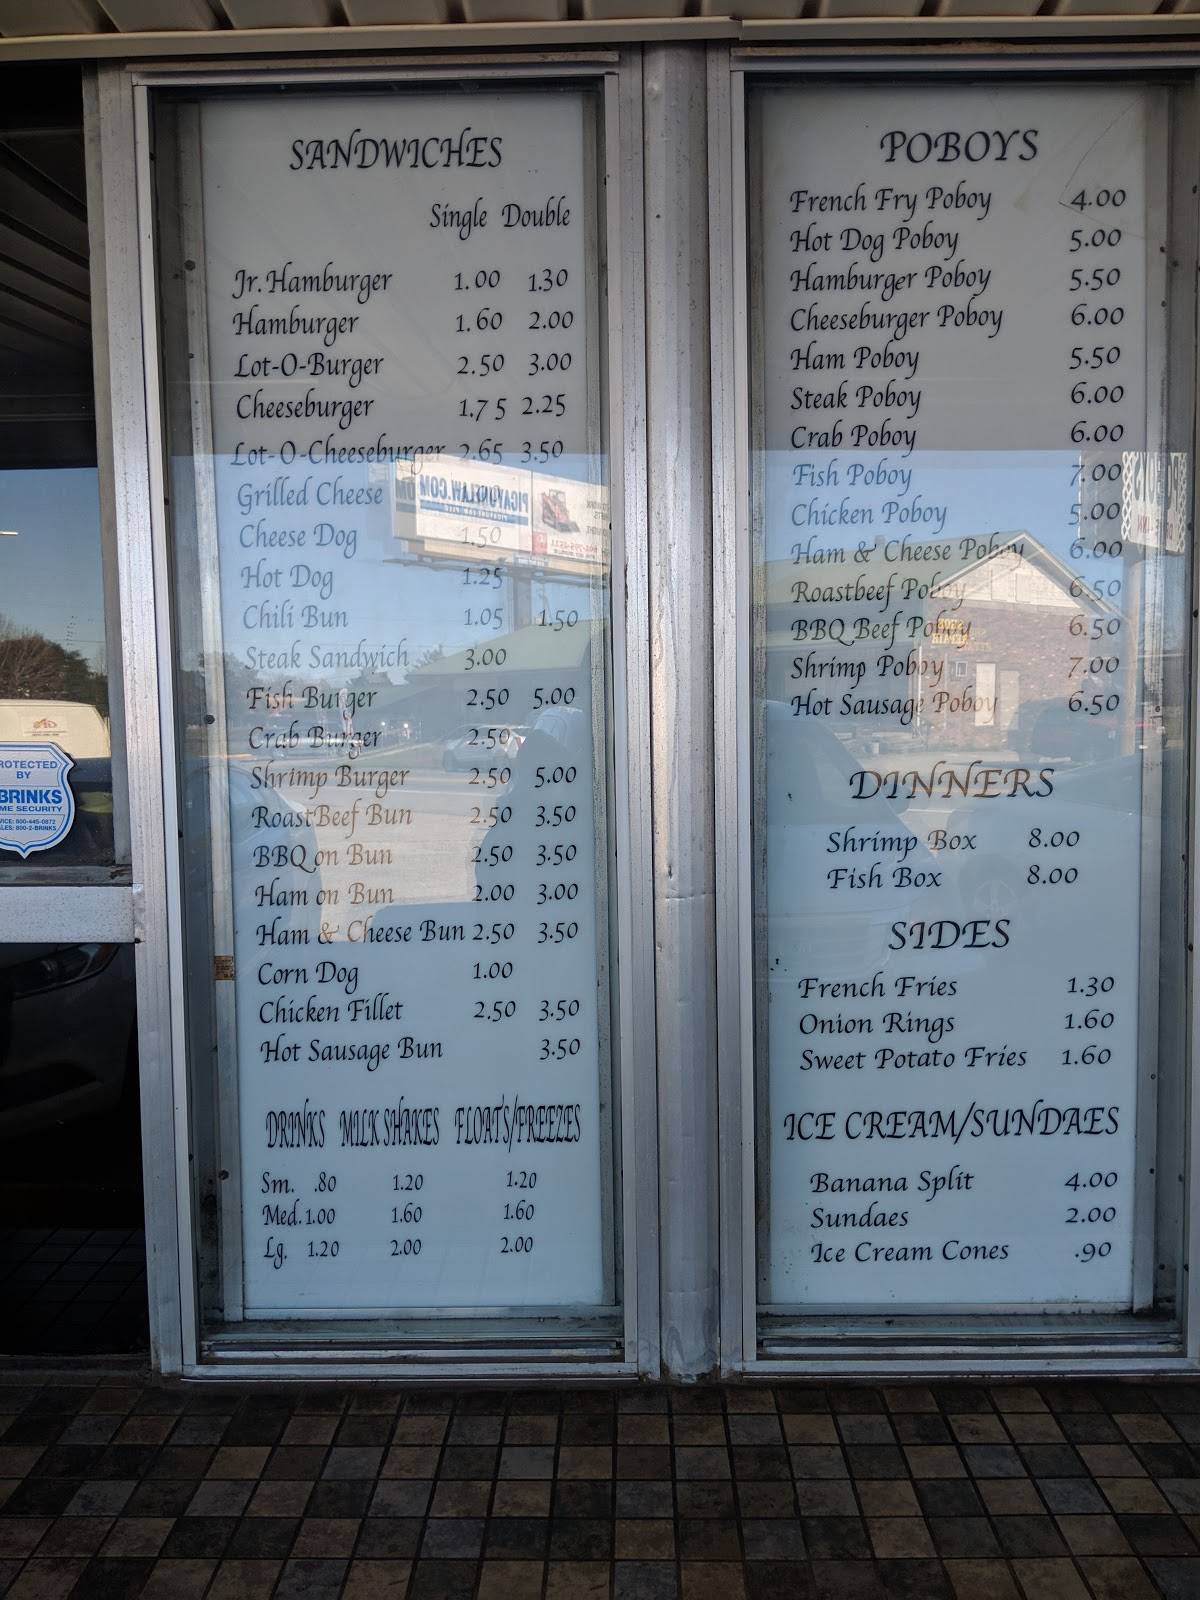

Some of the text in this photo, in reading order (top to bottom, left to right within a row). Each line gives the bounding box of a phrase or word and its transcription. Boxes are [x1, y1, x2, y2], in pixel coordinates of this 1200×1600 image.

[290, 127, 502, 170] SANDWICHES
[880, 129, 1038, 163] POBOYS
[430, 196, 570, 240] Single Double
[790, 180, 1126, 222] French Fry Poboy 4.00
[790, 220, 1121, 263] Hot Dog Poboy 5.00
[266, 261, 568, 304] Hamburger 1.00 1.30
[790, 259, 1120, 301] Hamburger Poboy 5.50
[233, 304, 573, 347] Hamburger 1.60 2.00
[790, 297, 1124, 340] Cheeseburger Poboy 6.00
[234, 353, 571, 388] Lot-O-Burger 2.50 3.00
[791, 339, 1120, 379] Ham Poboy 5.50
[237, 388, 565, 430] Cheeseburger 2.25
[791, 379, 1124, 419] Steak Poboy 6.00
[791, 418, 1123, 458] Crab Poboy 6.00
[237, 477, 308, 515] Grilled
[316, 475, 382, 505] Cheese
[793, 458, 912, 497] Fish Poboy
[792, 494, 947, 534] Chicken Poboy
[240, 518, 357, 559] Cheese Dog
[791, 535, 846, 564] Ham
[241, 558, 333, 600] Hot Dog
[792, 573, 898, 613] Roastbeef
[243, 599, 348, 629] Chili Bun
[791, 610, 904, 649] BBQ Beef
[244, 638, 506, 671] Steak Sandwich 3.00
[791, 649, 944, 691] Shrimp Poboy
[247, 680, 575, 721] Fish Burger 2.50 5.00
[791, 687, 1120, 725] Hot Sausage Poboy 6.50
[248, 721, 383, 760] Crab Burger
[0, 760, 58, 769] ROTECTED
[16, 771, 31, 779] BY
[250, 759, 576, 800] Shrimp Burger 2.50 5.00
[849, 760, 1056, 799] DINNERS
[0, 789, 63, 804] BRINKS
[251, 798, 576, 839] RoastBeef Bun 3.50
[253, 845, 576, 873] BBQ 2.50 3.50
[827, 826, 1079, 863] Shrimp Box 8.00
[255, 877, 578, 907] Ham 2.00 3.00
[827, 862, 1078, 888] Fish Box 8.00
[256, 916, 578, 946] Ham Cheese Bun 2.50 3.50
[888, 919, 1010, 950] SIDES
[258, 963, 308, 985] Corn
[316, 962, 358, 994] Dog
[474, 962, 512, 979] 1.00
[798, 971, 1114, 998] French Fries 1.30
[260, 993, 579, 1023] Chicken Fillet 2.50 3.50
[800, 1009, 1114, 1043] Onion Rings 1.60
[260, 1033, 580, 1071] Hot Sausage Bun 3.50
[800, 1045, 1111, 1070] Sweet Potato Fries 1.60
[266, 1094, 580, 1152] DRINKS MILK SHAKES FLOATS/FREEZES
[784, 1099, 1119, 1144] ICE CREAM/SUNDAES
[262, 1171, 536, 1193] Sm. 1.20 1.20
[810, 1165, 1117, 1202] Banana Split 4.00
[262, 1199, 534, 1226] Med. 1.60 1.60
[811, 1201, 1116, 1228] Sundaes 2.00
[264, 1236, 533, 1269] Lg. 1.20 2.00 2.00
[811, 1240, 1008, 1262] Ice Cream Cones
